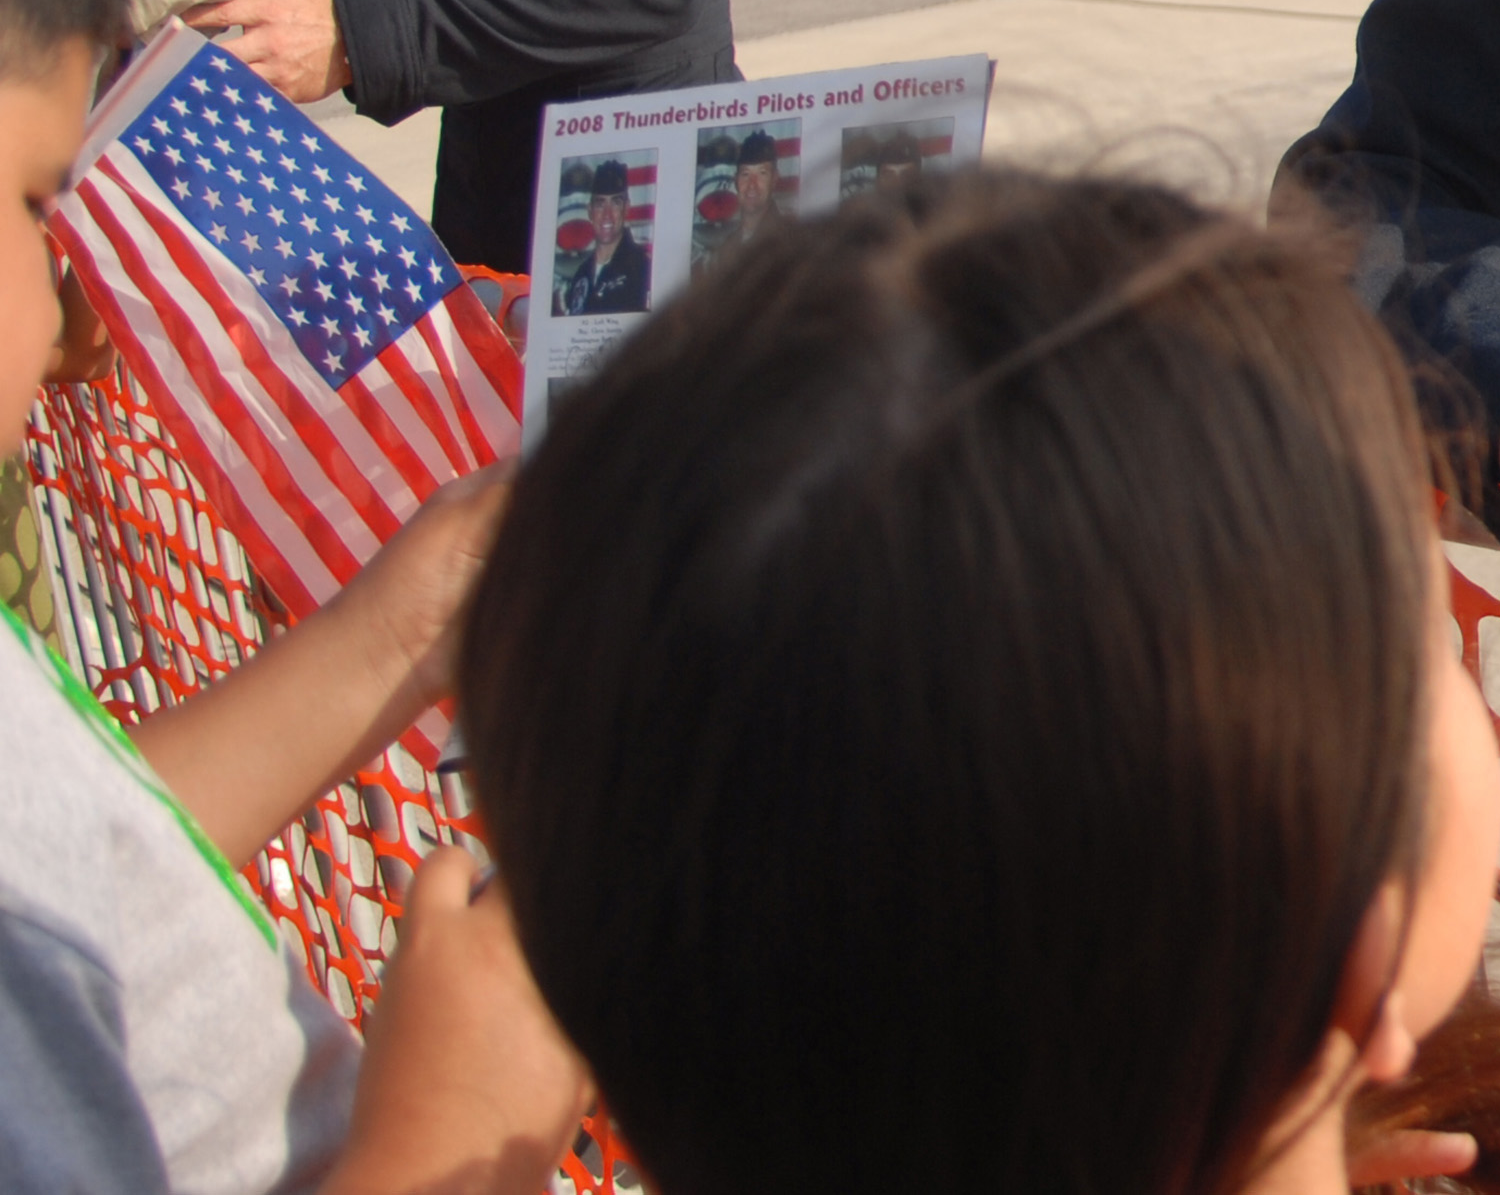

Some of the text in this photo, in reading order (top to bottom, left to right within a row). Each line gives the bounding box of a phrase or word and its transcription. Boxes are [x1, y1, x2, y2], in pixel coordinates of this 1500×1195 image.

[555, 76, 966, 137] 2008 Thunderbirds Pilots and Officers
